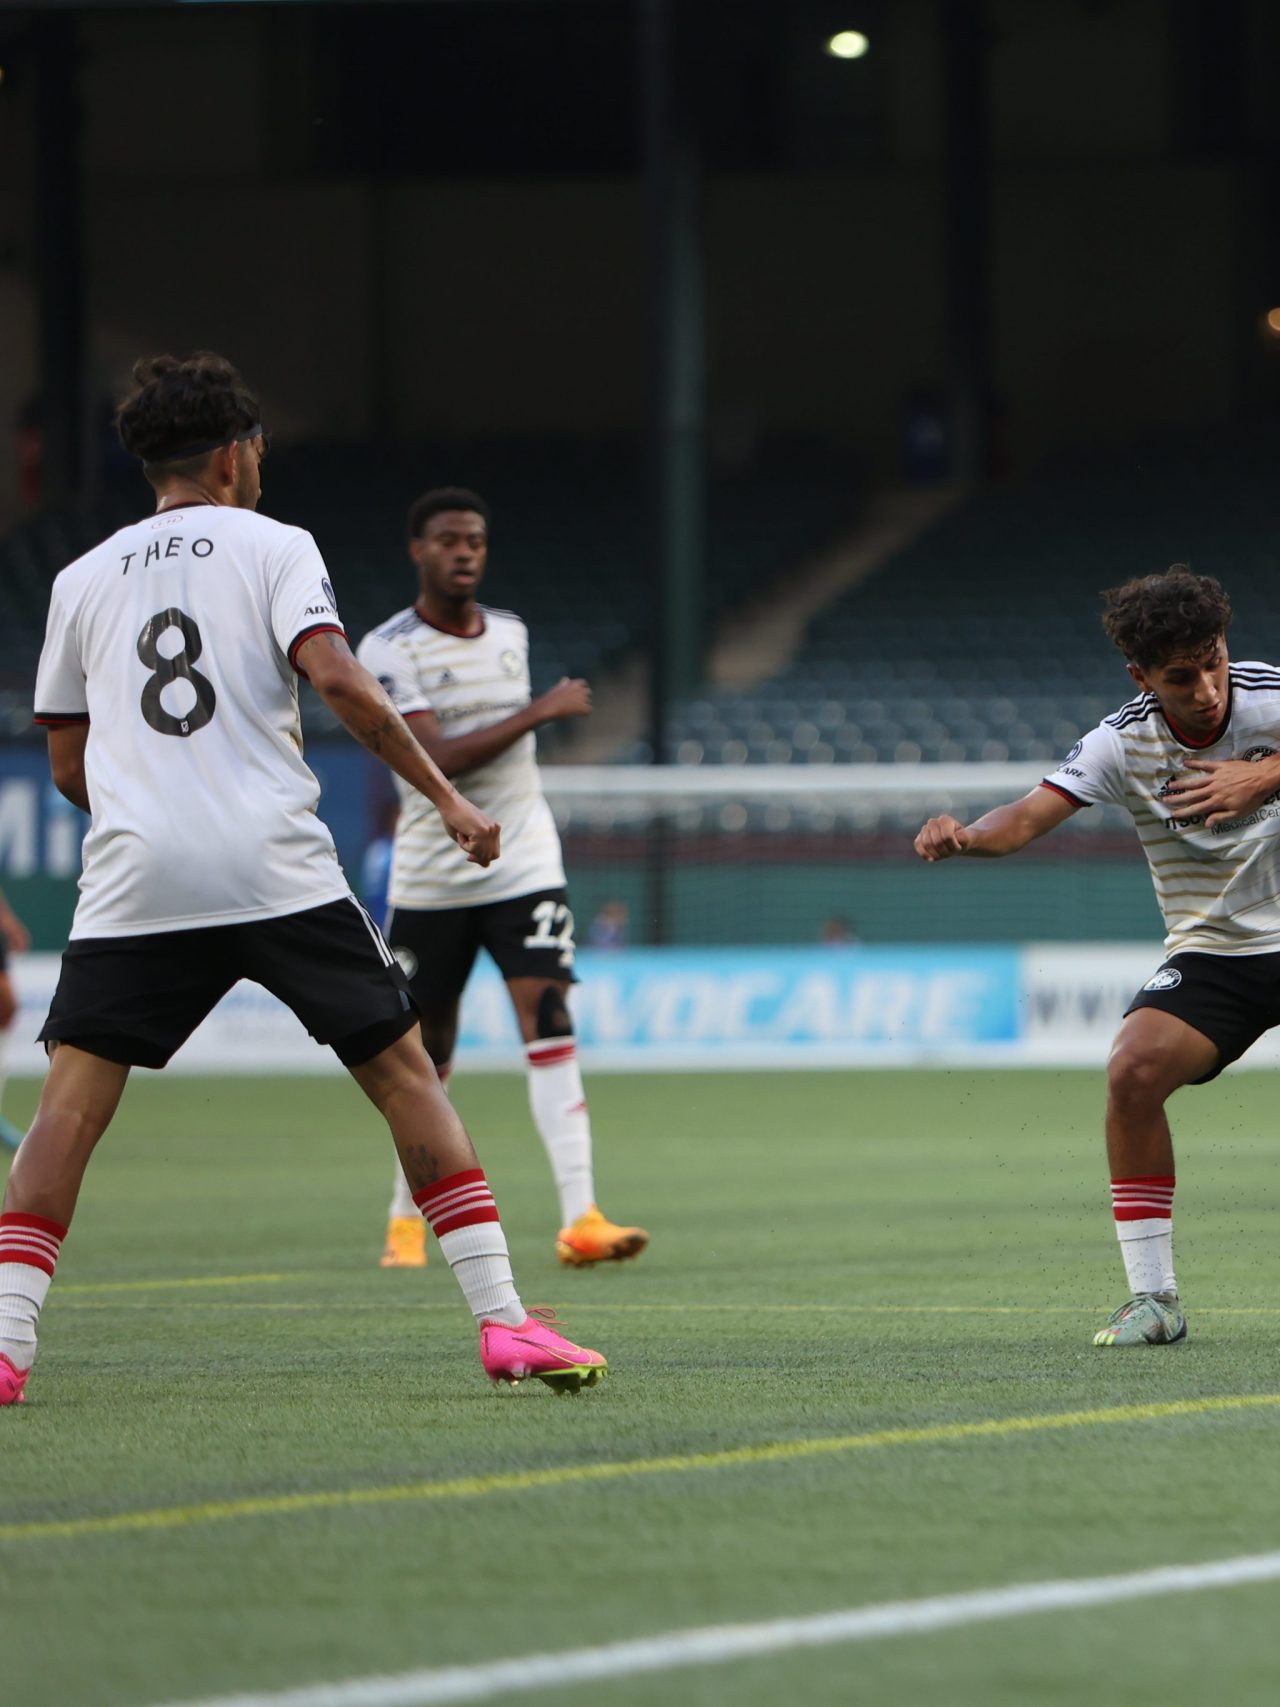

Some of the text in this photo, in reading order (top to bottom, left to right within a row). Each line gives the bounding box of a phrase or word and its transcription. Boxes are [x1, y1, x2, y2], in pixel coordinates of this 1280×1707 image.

[121, 536, 214, 575] THEO
[137, 607, 217, 737] 8
[1211, 812, 1260, 836] Medical
